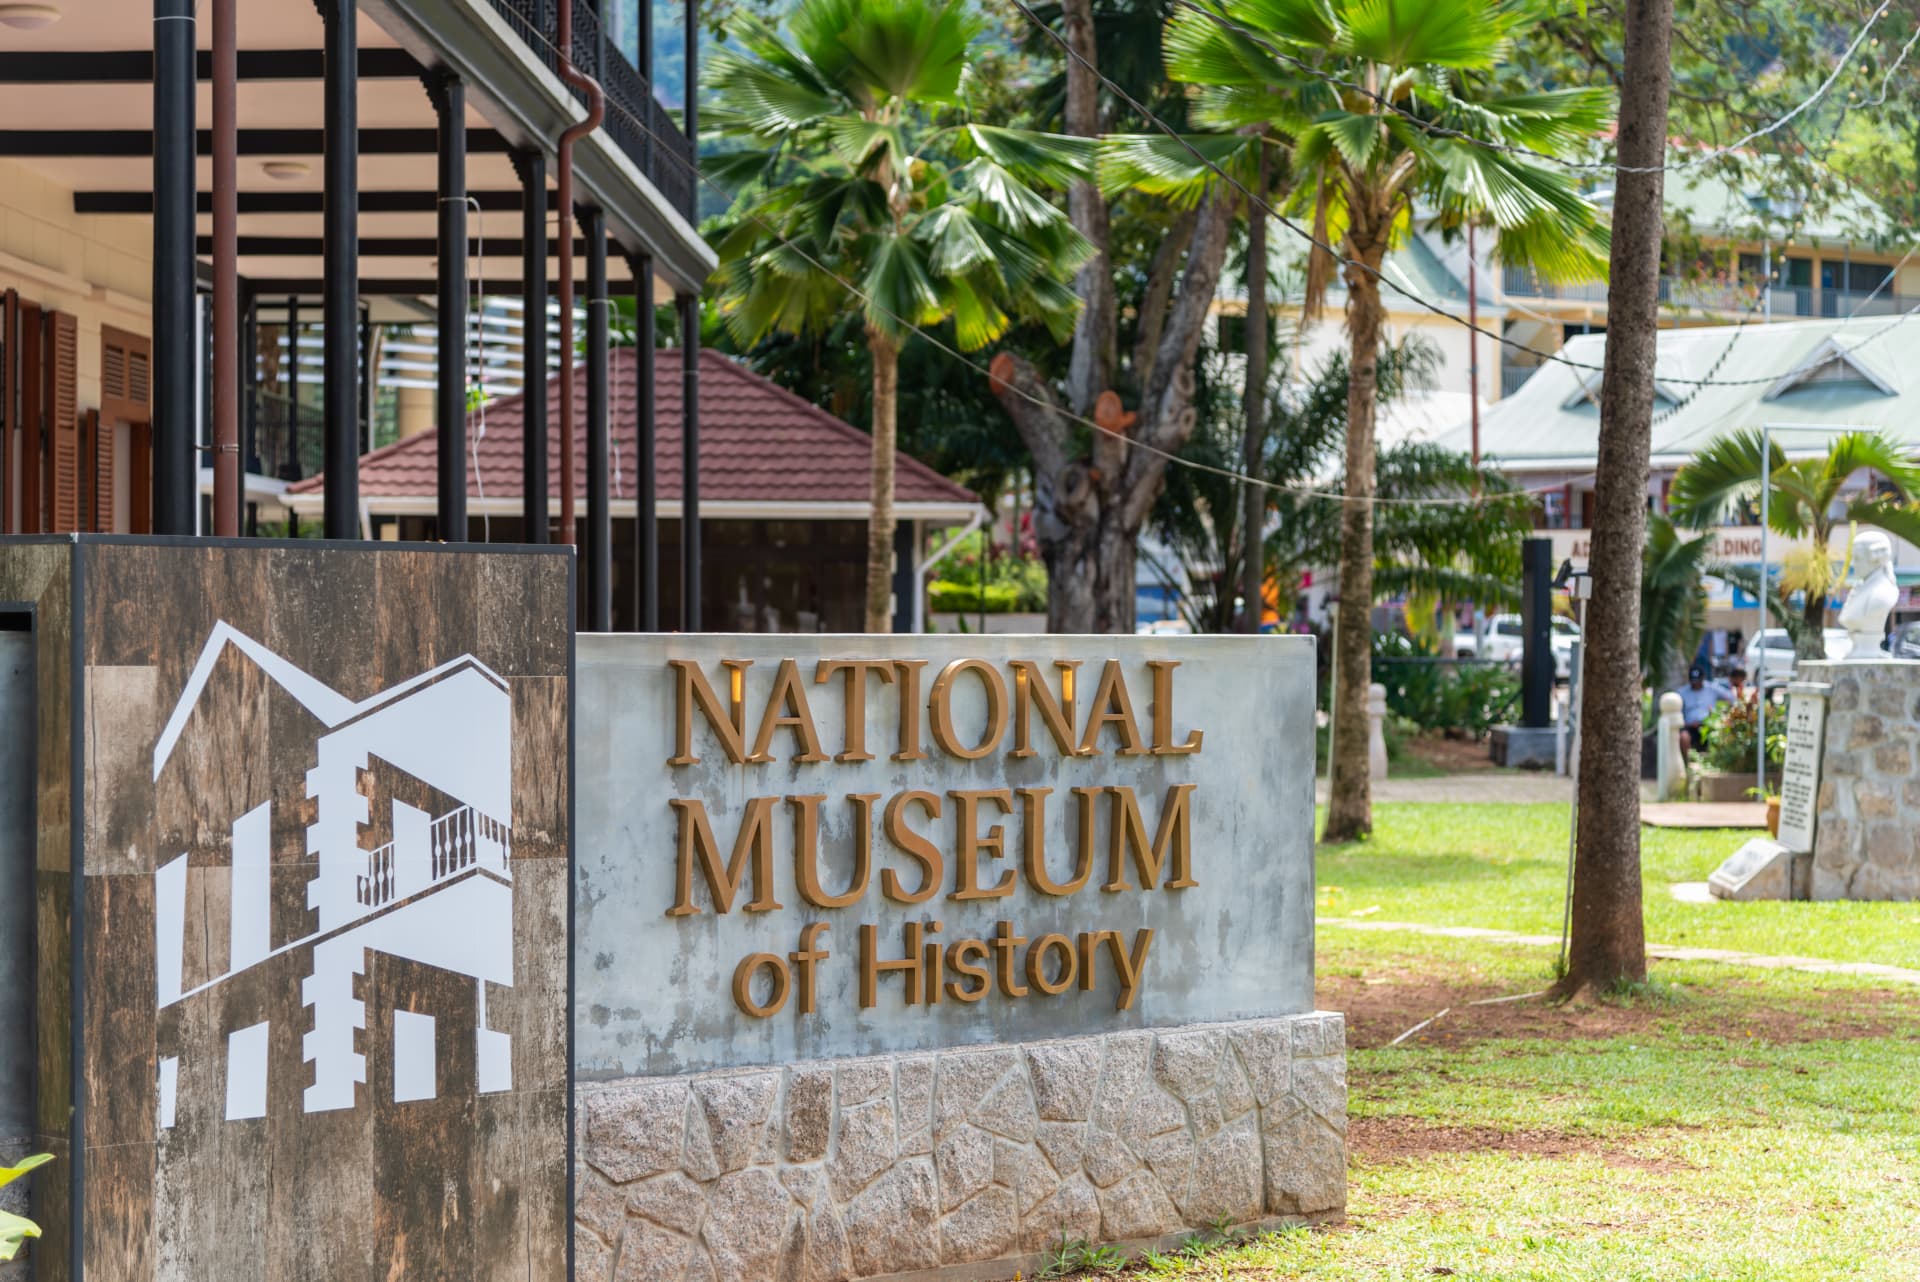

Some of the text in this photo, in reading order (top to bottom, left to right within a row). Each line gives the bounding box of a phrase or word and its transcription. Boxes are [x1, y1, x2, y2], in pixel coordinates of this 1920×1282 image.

[668, 659, 1203, 766] NATIONAL
[666, 785, 1199, 916] MUSEUM
[733, 921, 1153, 1017] of History
